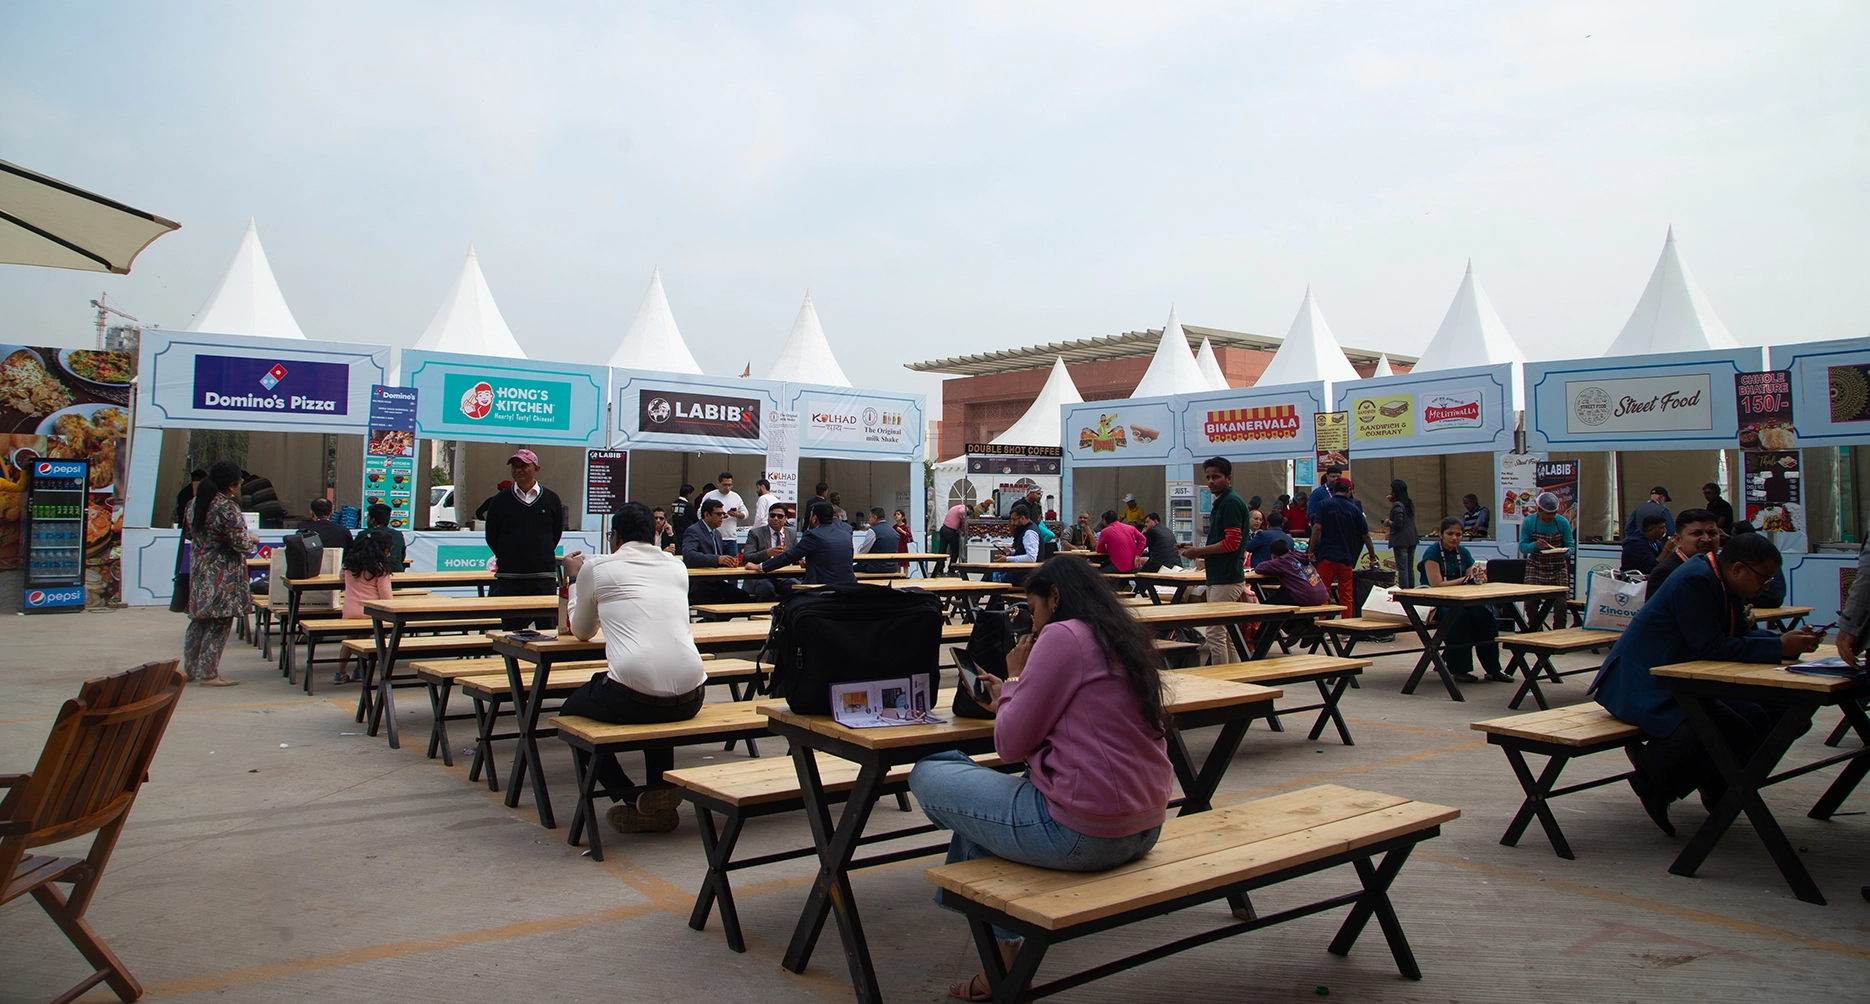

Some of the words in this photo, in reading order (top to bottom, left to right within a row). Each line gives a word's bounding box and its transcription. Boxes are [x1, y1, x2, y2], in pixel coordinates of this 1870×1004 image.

[1741, 373, 1785, 385] CHHOLE
[496, 387, 549, 401] HONG'S
[1739, 383, 1789, 395] BHATURE
[205, 391, 285, 409] Domino's
[290, 395, 336, 411] Pizza
[383, 391, 416, 400] Domino's
[495, 400, 554, 414] KITCHEN
[1614, 395, 1660, 418] Street
[1660, 390, 1701, 412] Food
[1741, 394, 1789, 413] 150/-
[494, 412, 514, 422] Hearty!
[516, 413, 531, 423] Tasty!
[812, 412, 857, 424] KLHAD
[877, 427, 902, 436] Original
[1207, 417, 1297, 434] BIKANERVALA
[1360, 422, 1400, 431] SANDWICH
[1365, 429, 1403, 437] COMPANY
[968, 444, 1002, 454] DOUBLE
[1003, 445, 1026, 454] SHOT
[1027, 446, 1060, 456] COFFEE
[53, 465, 81, 475] pepsi
[767, 471, 797, 481] KLHAD
[1174, 487, 1188, 495] JUST
[444, 558, 485, 567] HONG'S
[47, 590, 82, 604] pepsi
